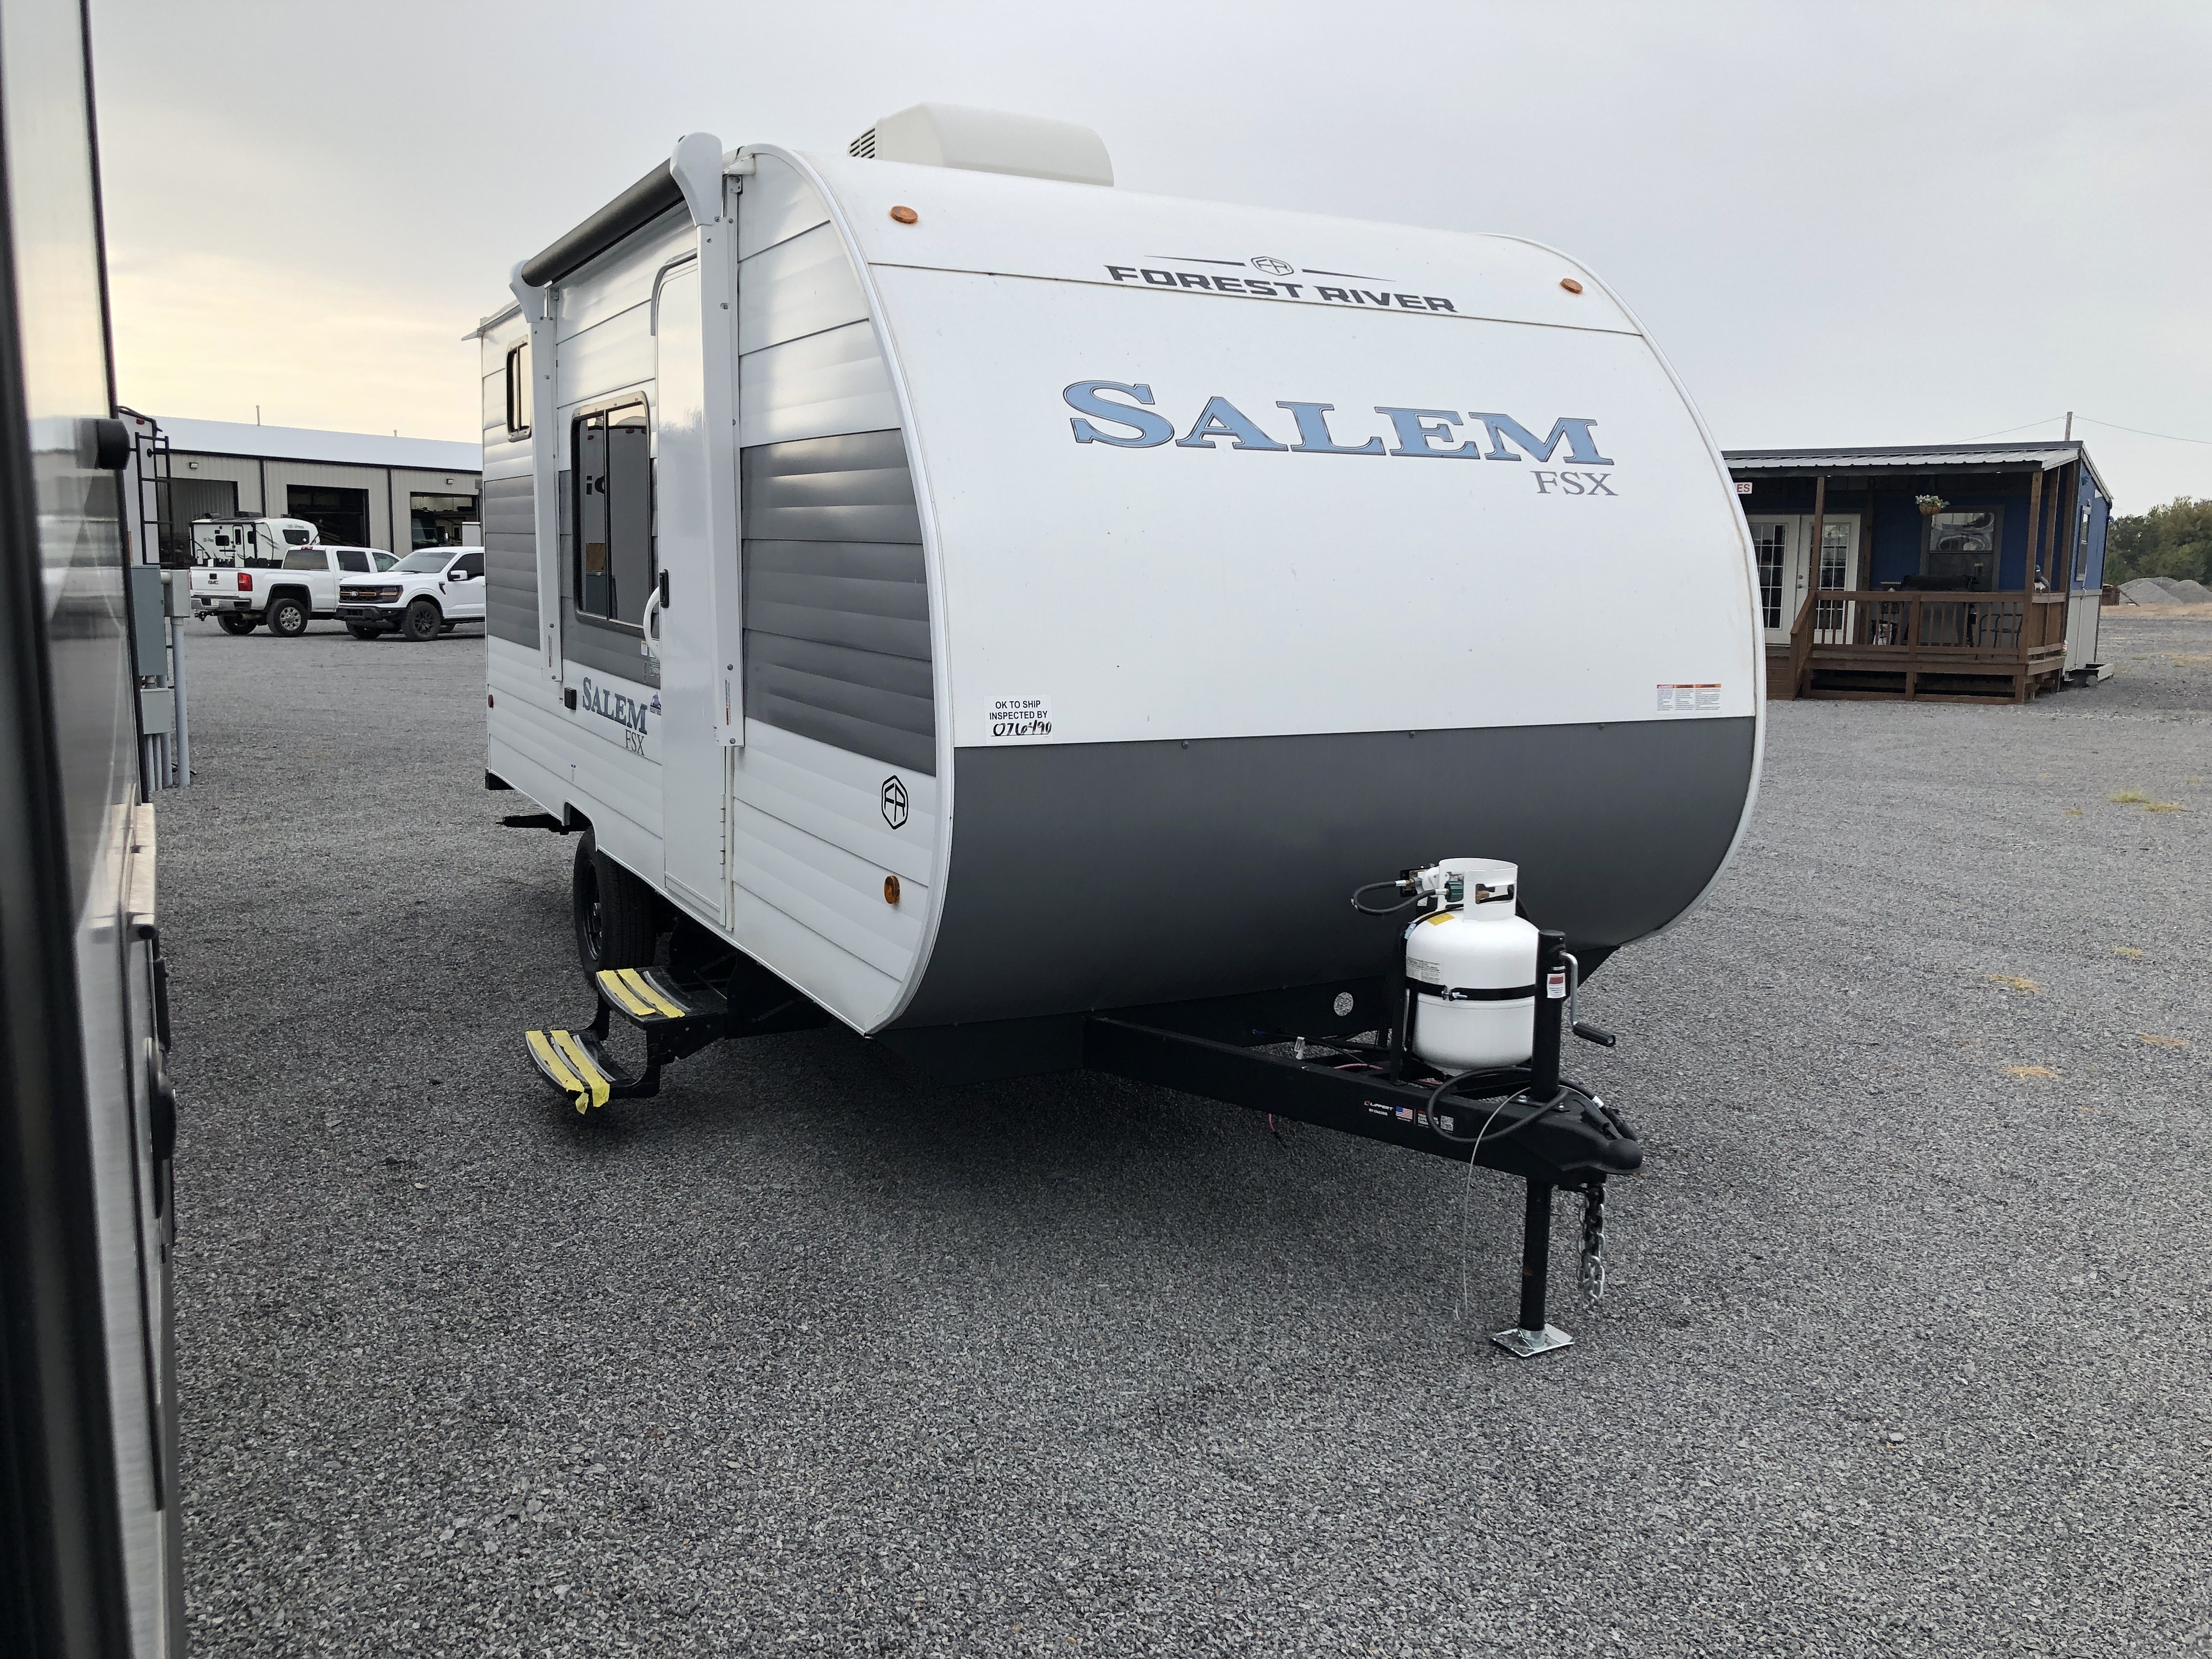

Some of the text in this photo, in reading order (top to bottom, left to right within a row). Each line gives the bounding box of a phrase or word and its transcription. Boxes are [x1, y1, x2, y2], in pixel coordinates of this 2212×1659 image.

[1103, 264, 1459, 313] FOREST RIVER
[1063, 380, 1615, 466] SALEM
[1530, 470, 1619, 496] FSX
[582, 676, 648, 735] SALEM
[989, 710, 1048, 720] INSPECTED BY
[1009, 701, 1020, 709] TO
[1023, 700, 1041, 708] SHIP
[625, 729, 645, 757] FSX
